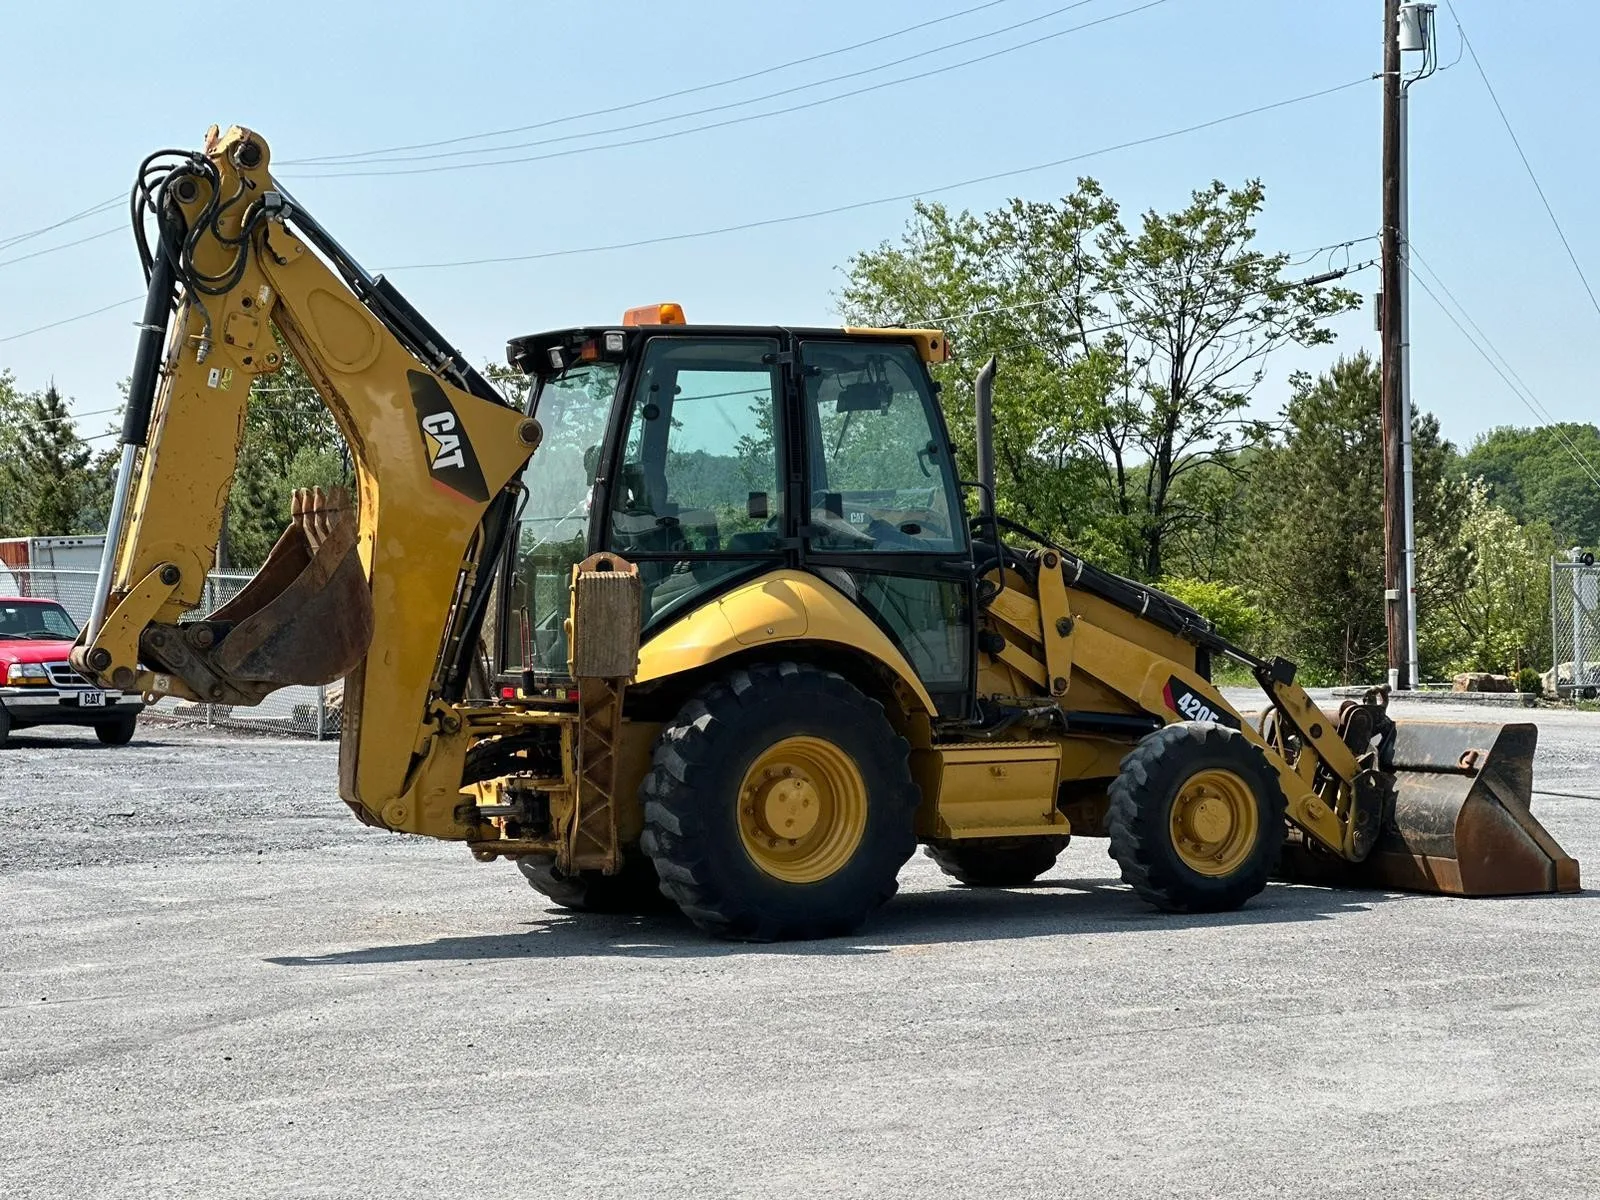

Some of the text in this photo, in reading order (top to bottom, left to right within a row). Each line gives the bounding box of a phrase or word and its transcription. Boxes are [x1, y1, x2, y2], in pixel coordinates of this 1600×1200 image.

[422, 411, 465, 470] CAT
[850, 512, 865, 523] CAT
[84, 693, 101, 705] CAT
